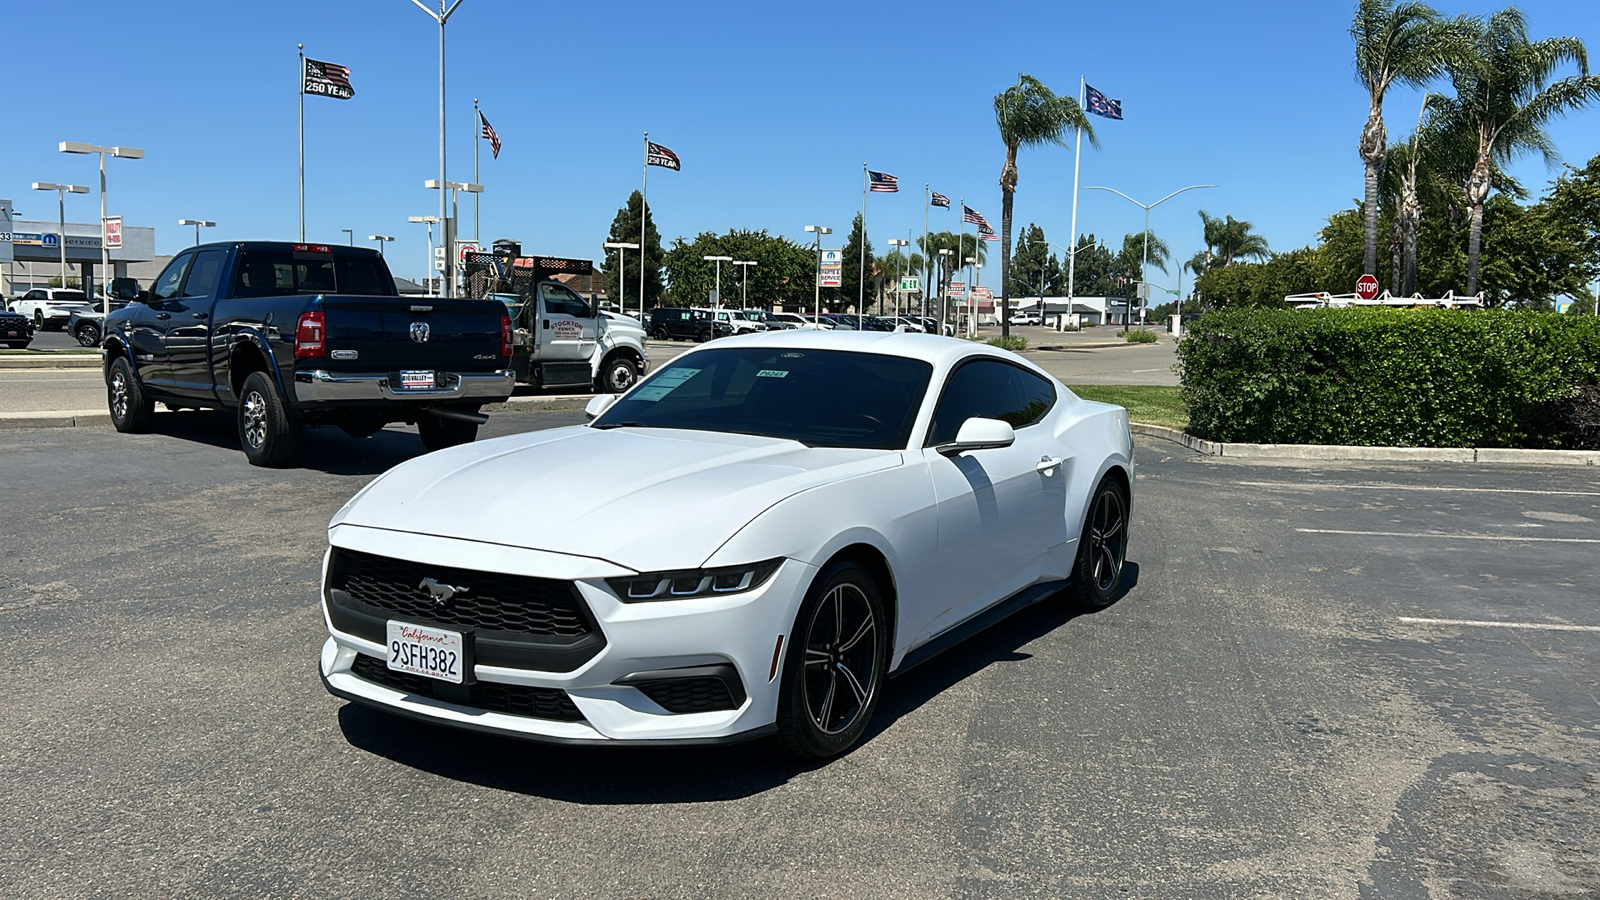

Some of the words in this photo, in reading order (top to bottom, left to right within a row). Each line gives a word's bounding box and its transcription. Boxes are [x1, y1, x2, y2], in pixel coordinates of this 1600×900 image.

[306, 81, 325, 93] 250
[648, 157, 660, 165] 250
[64, 237, 100, 246] Service
[1358, 282, 1377, 293] STOP
[551, 320, 584, 330] STOCKTON
[402, 626, 448, 645] California
[392, 640, 457, 675] 9SFH382
[405, 666, 444, 677] dmv.ca.gov
